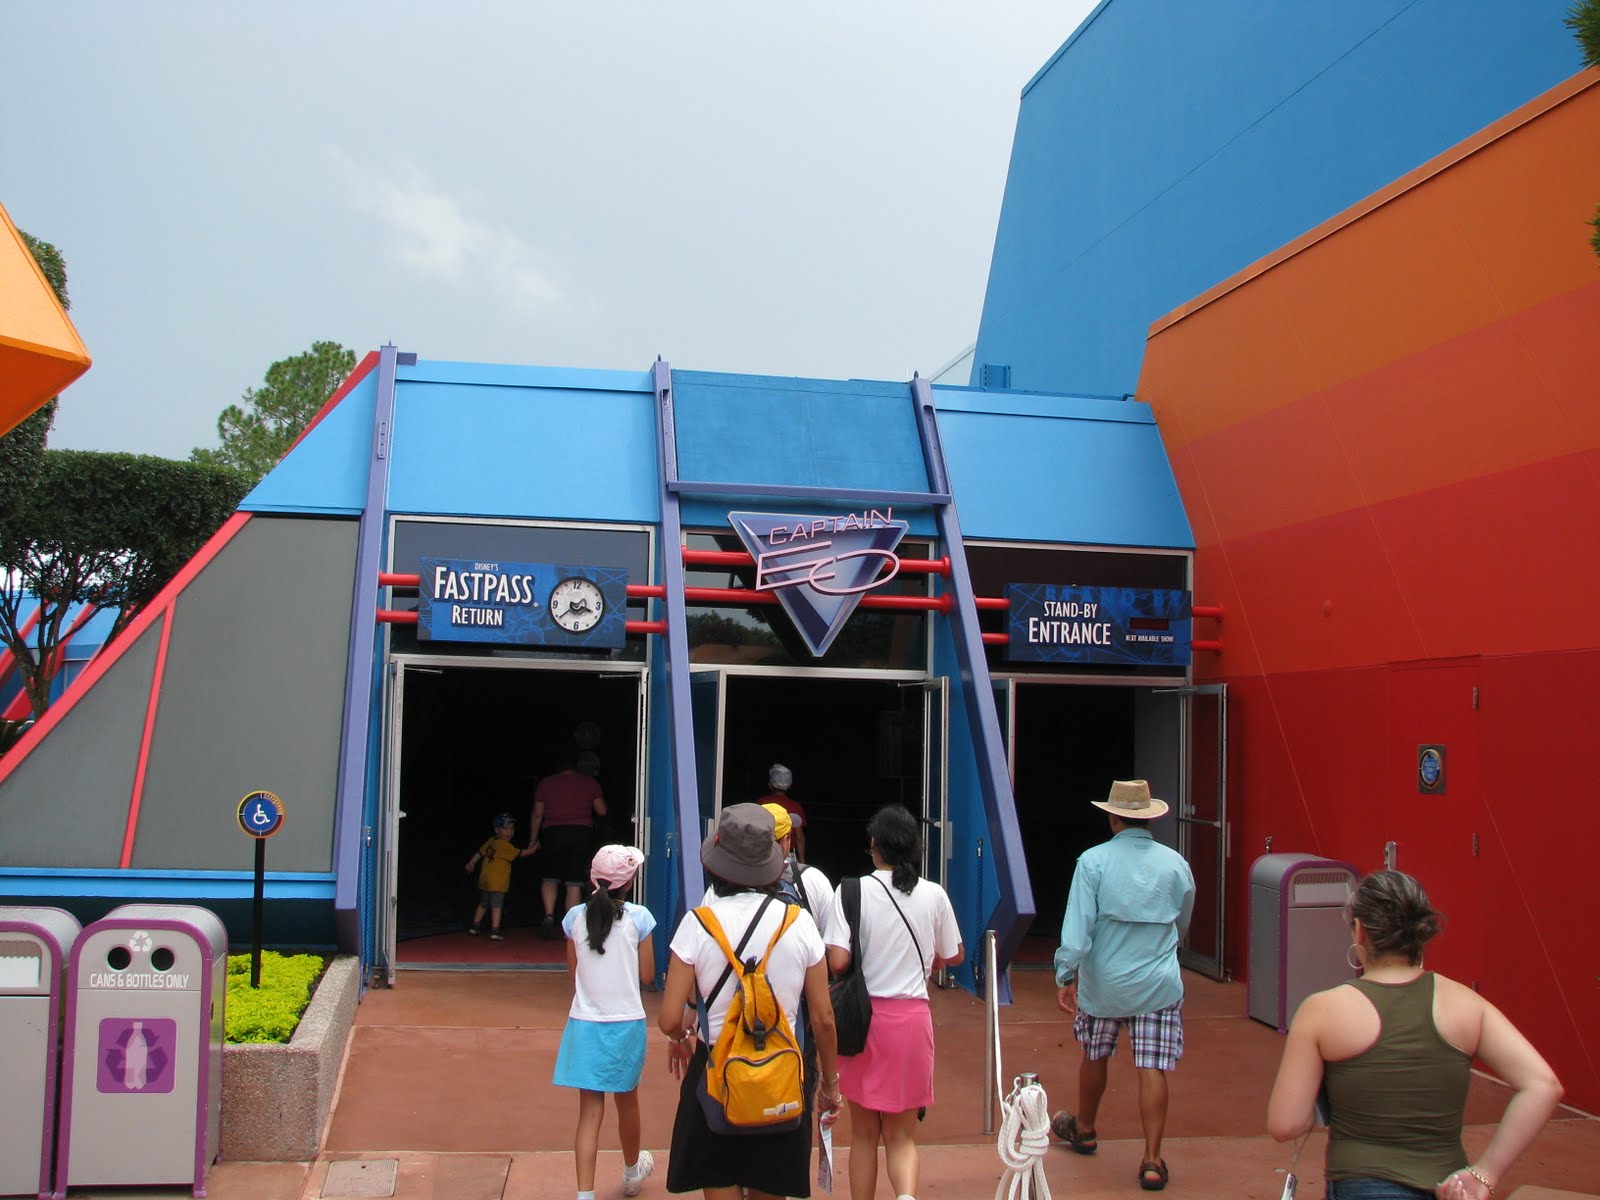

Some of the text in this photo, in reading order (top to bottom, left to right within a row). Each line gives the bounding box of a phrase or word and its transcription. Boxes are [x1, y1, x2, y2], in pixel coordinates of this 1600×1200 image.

[769, 507, 892, 546] CAPTAIN
[474, 562, 499, 572] DISNEY'S
[756, 540, 900, 596] EO
[434, 566, 533, 604] FASTPASS
[573, 580, 582, 590] 12
[552, 600, 559, 609] 9
[595, 601, 602, 611] 3
[1043, 601, 1098, 619] STAND-BY
[452, 605, 503, 626] RETURN
[573, 621, 580, 631] 6
[1028, 617, 1111, 645] ENTRANCE
[1125, 634, 1137, 642] NEXT
[1160, 635, 1174, 643] SHOW
[90, 973, 190, 989] CANS & BOTTLES ONLY
